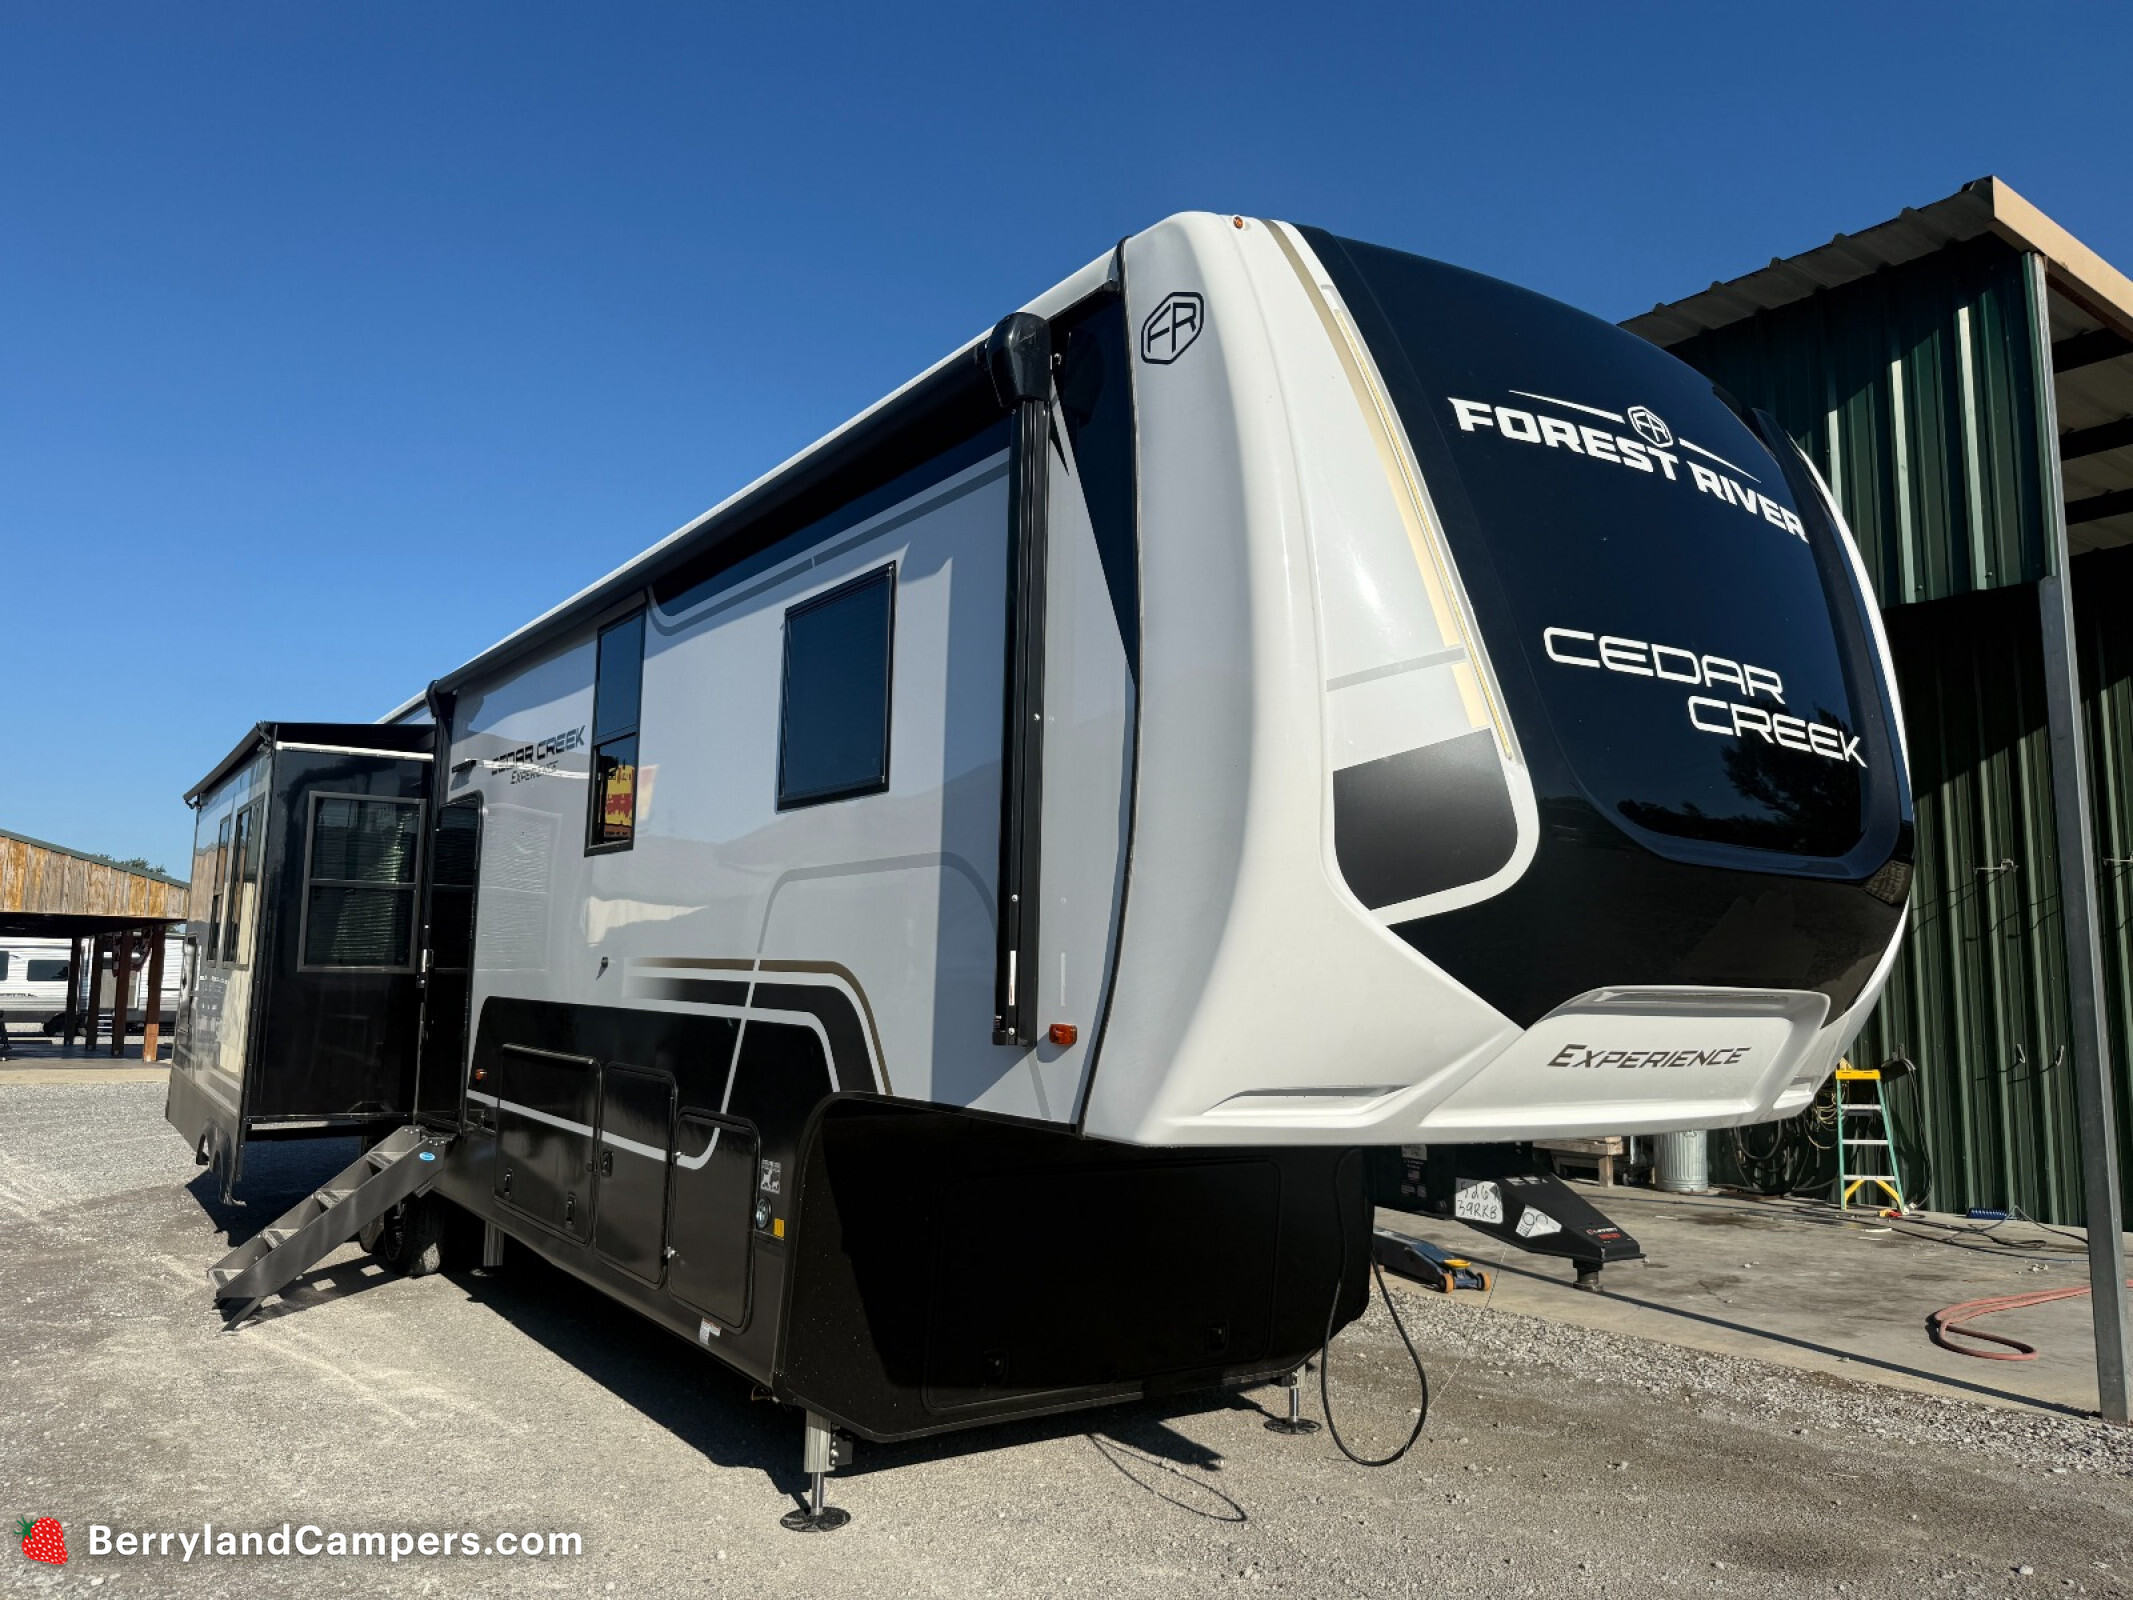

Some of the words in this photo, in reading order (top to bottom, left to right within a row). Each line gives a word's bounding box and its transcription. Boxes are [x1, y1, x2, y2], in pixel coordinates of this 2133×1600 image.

[1446, 397, 1679, 481] FOREST
[1686, 460, 1810, 545] RIVER
[1543, 626, 1786, 705] CEDAR
[536, 725, 586, 760] CREEK
[1688, 695, 1868, 768] CREEK
[510, 760, 559, 785] EXPERIECE
[1547, 1043, 1752, 1069] EXPERIENCE
